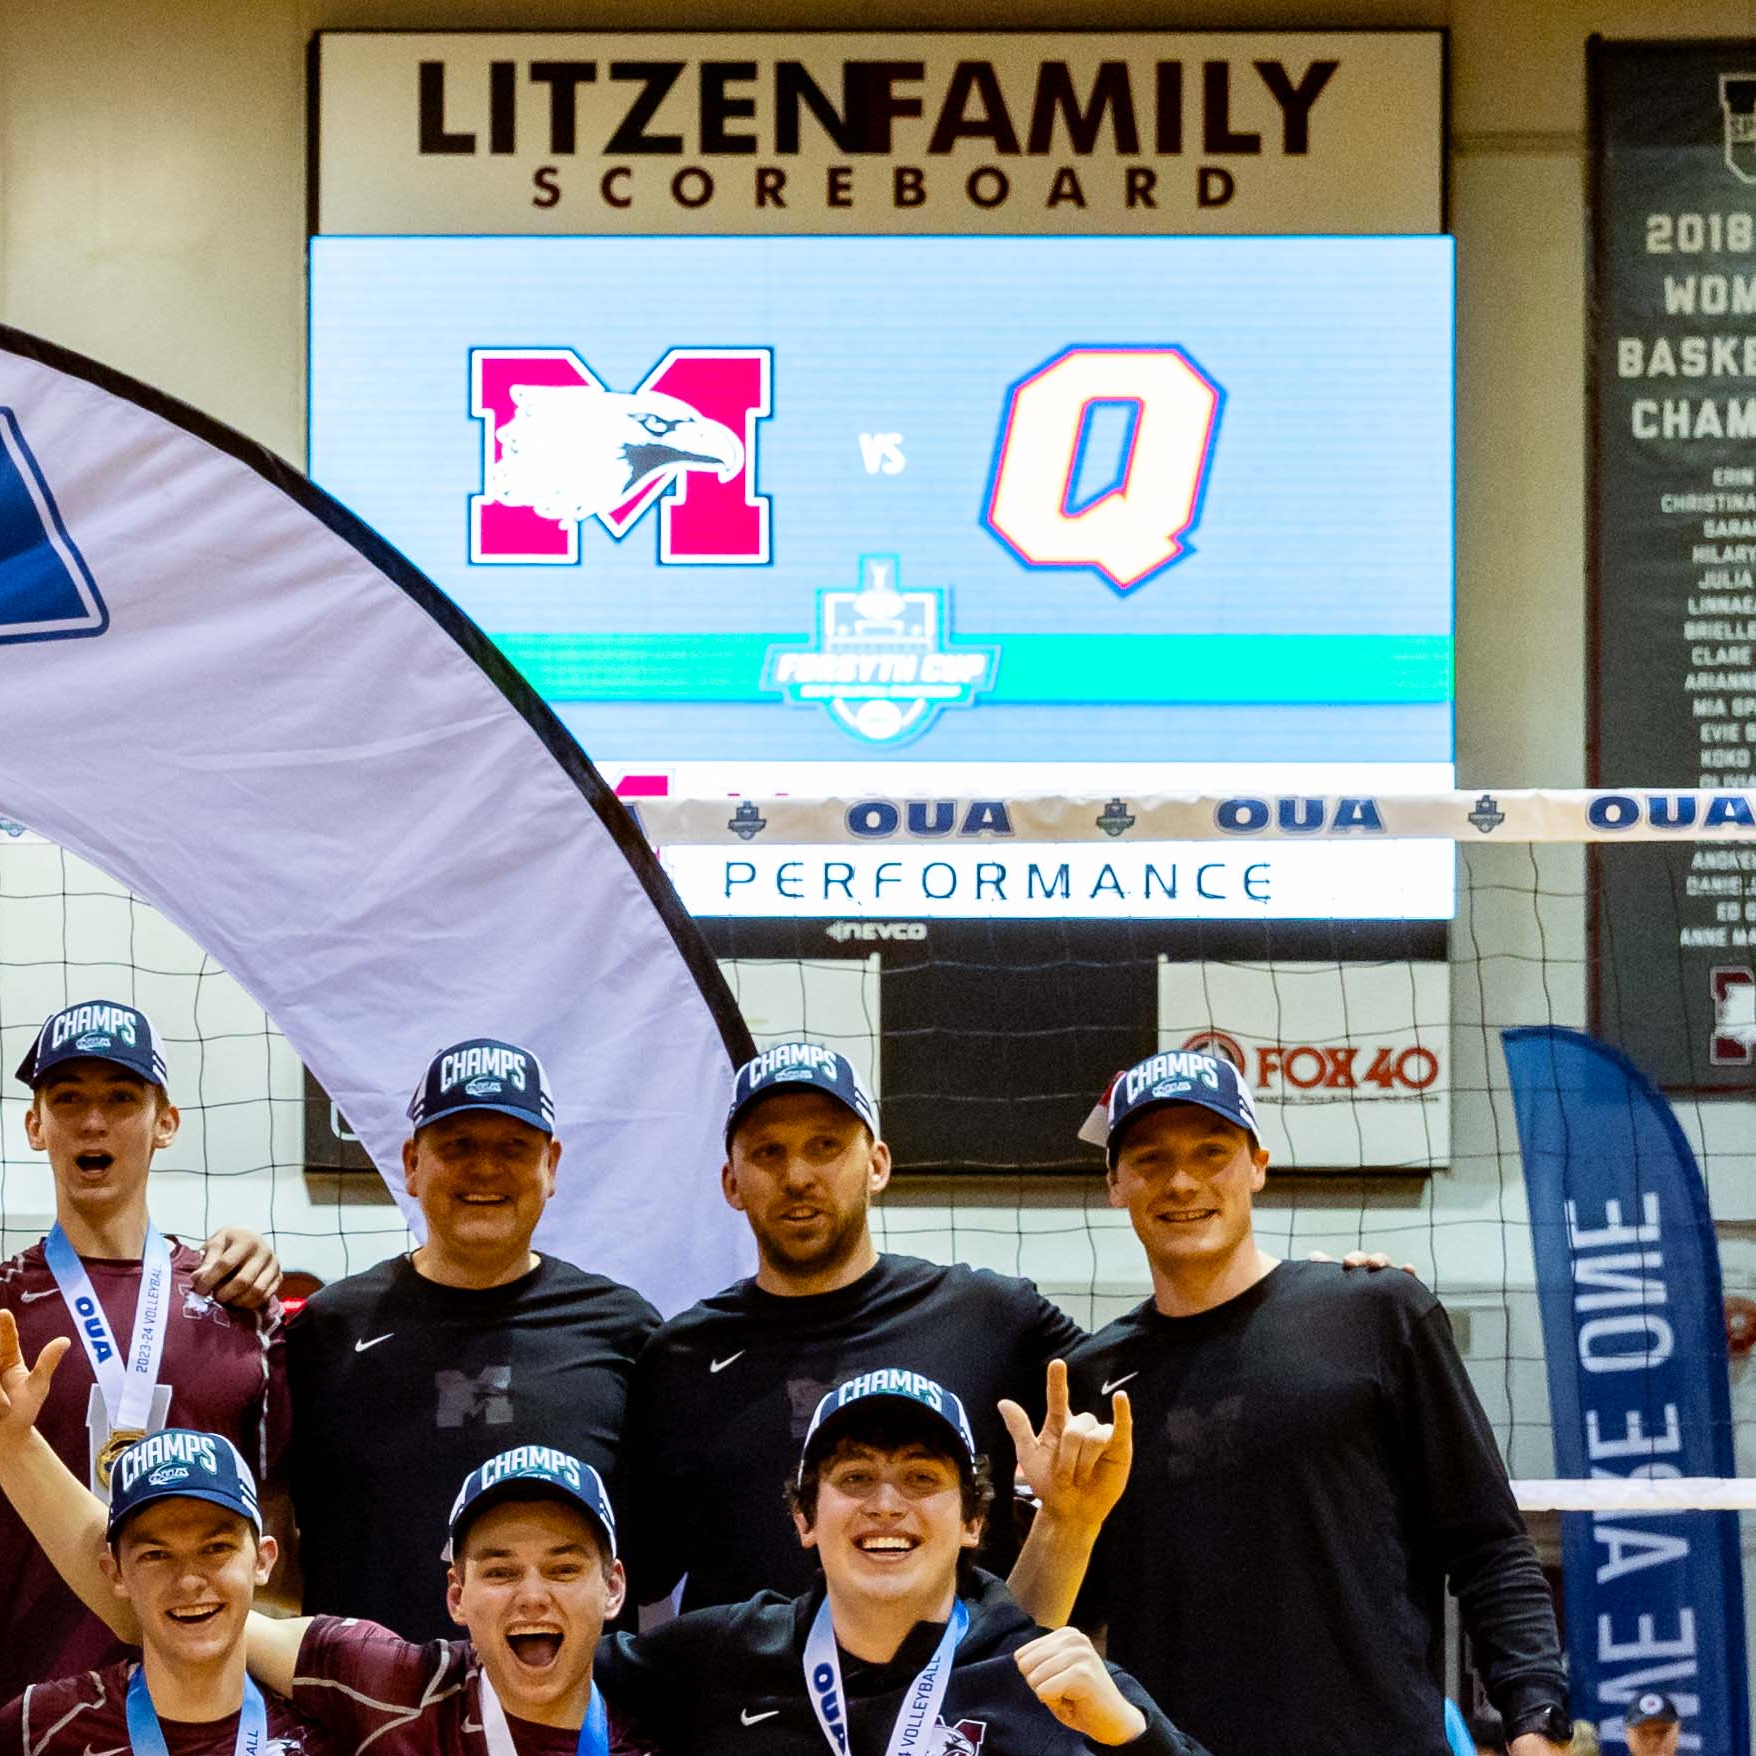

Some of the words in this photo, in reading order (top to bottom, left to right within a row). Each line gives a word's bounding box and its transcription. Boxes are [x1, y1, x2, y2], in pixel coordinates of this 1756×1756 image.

[531, 165, 1238, 209] SCOREBOARD
[844, 797, 1014, 840] OUA
[1213, 795, 1386, 834] OUA
[1588, 795, 1756, 831] OUA
[725, 861, 1274, 901] PERFORMANCE
[52, 1004, 138, 1050] CHAMPS
[439, 1046, 527, 1093] CHAMPS
[748, 1041, 838, 1089] CHAMPS
[1126, 1052, 1219, 1106] CHAMPS
[1255, 1046, 1358, 1088] FOX
[1364, 1046, 1439, 1089] 40
[140, 1262, 164, 1333] VOLLEYBALL
[75, 1295, 115, 1365] OUA
[135, 1329, 151, 1375] 2023-24
[837, 1367, 944, 1411] CHAMPS
[120, 1431, 218, 1492] CHAMPS
[479, 1444, 582, 1490] CHAMPS
[902, 1654, 941, 1750] VOLLEYBALL
